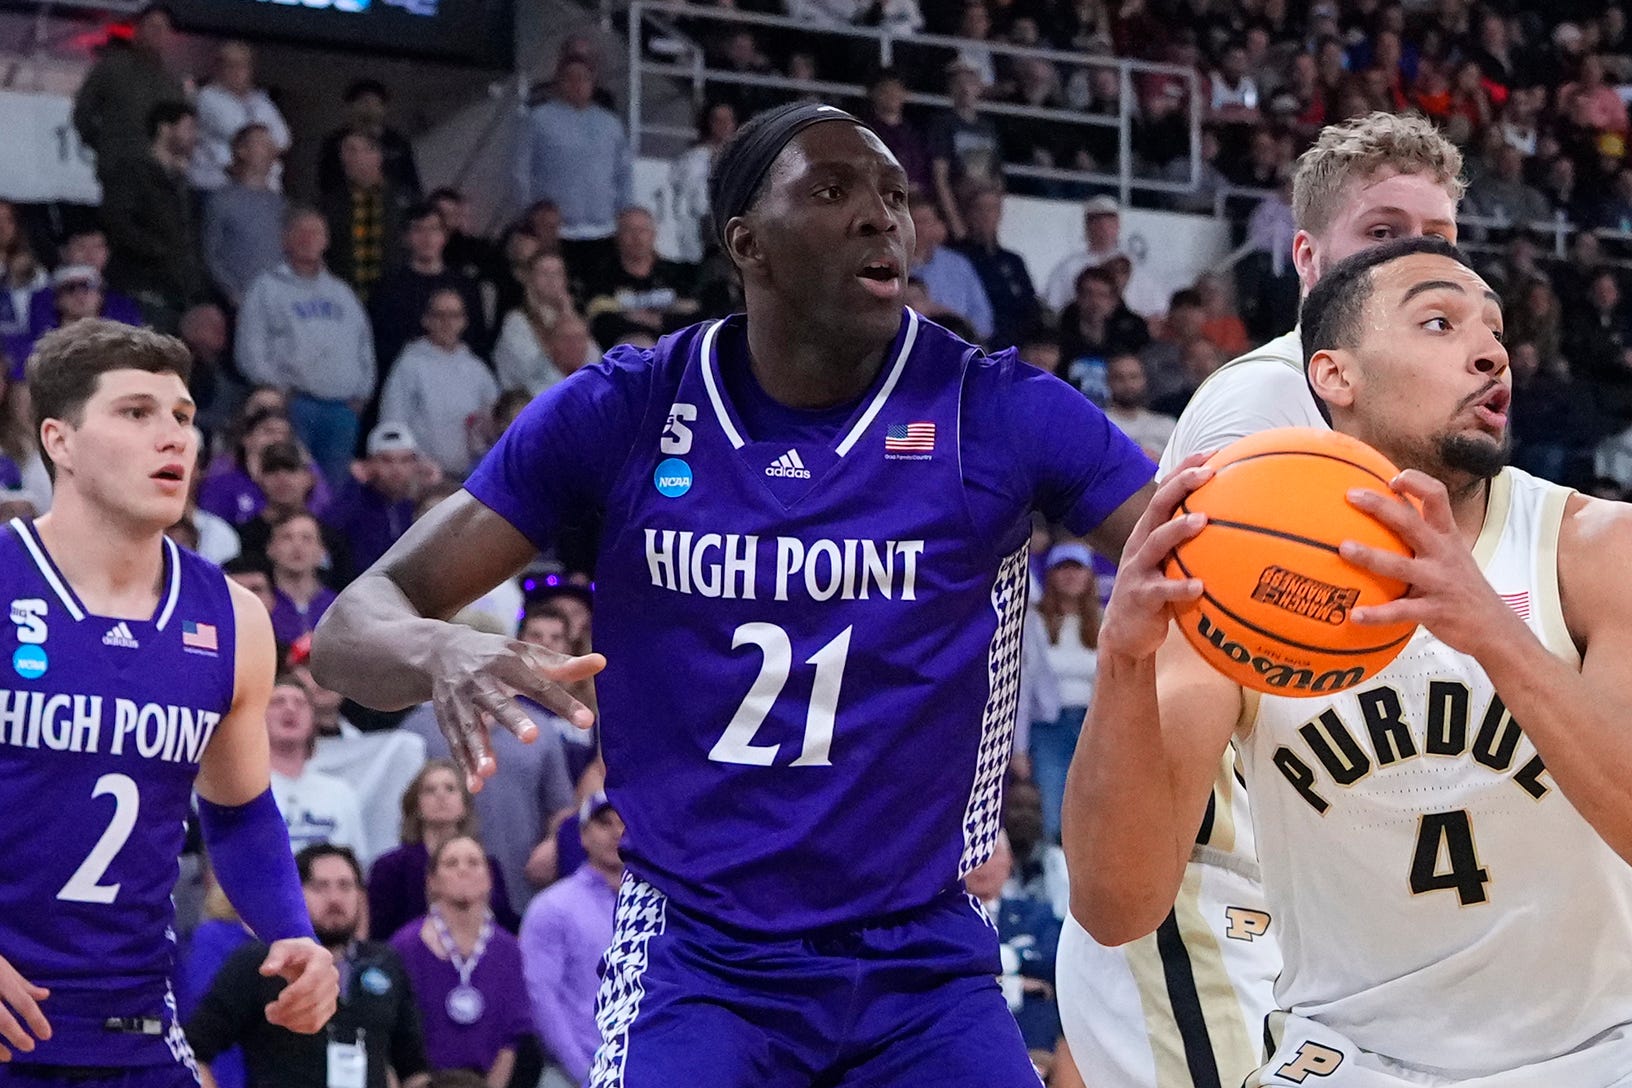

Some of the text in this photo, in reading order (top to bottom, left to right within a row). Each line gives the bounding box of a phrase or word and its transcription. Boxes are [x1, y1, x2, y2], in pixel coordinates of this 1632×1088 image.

[659, 477, 691, 488] NCAA
[765, 466, 811, 479] adidas
[644, 528, 925, 602] HIGH POINT
[1197, 612, 1366, 693] Wilson
[0, 688, 221, 764] HIGH POINT
[707, 621, 853, 768] 21
[56, 773, 140, 904] 2
[1409, 807, 1493, 909] 4
[1225, 906, 1272, 943] P
[1273, 1040, 1345, 1085] P
